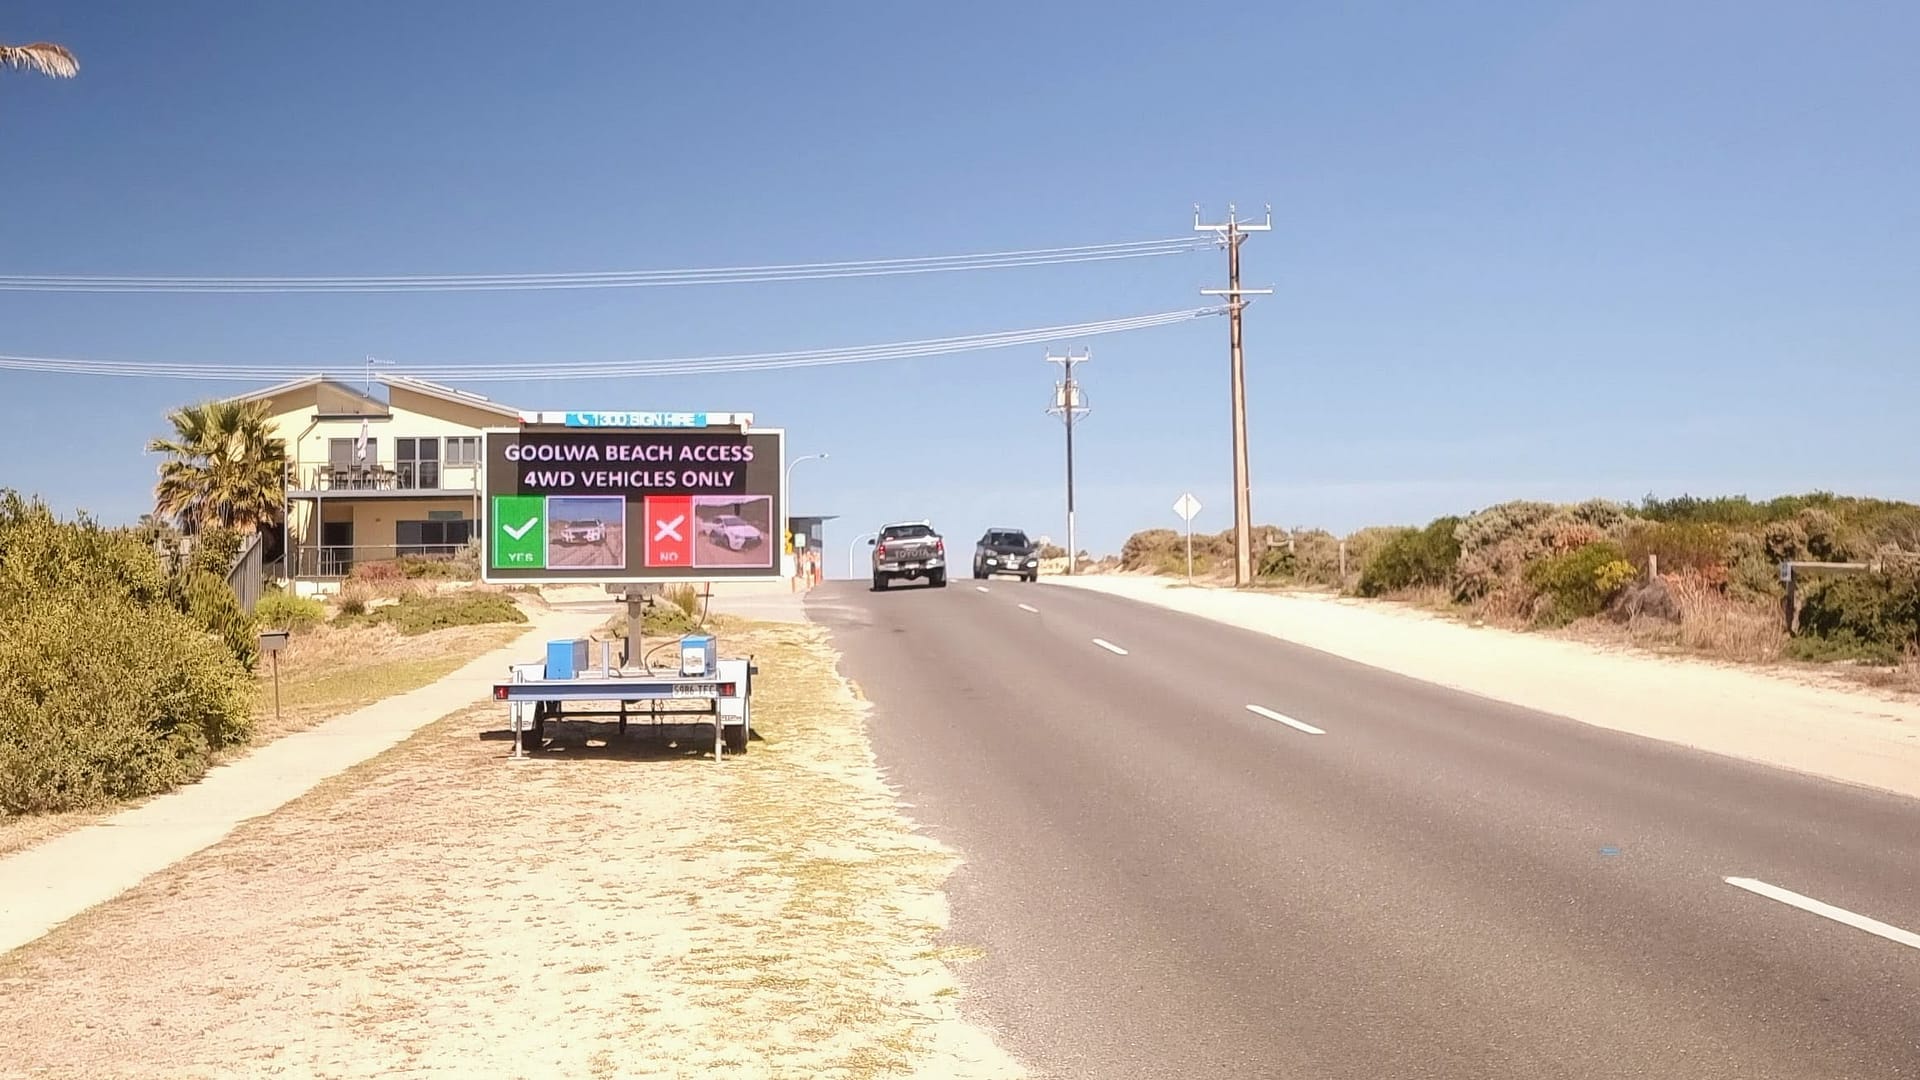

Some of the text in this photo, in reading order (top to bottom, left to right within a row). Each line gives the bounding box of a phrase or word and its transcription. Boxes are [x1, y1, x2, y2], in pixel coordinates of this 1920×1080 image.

[504, 443, 754, 462] GOOLWA BEACH ACCESS
[524, 470, 735, 488] 4WD VEHICLES ONLY
[508, 552, 534, 562] YES
[659, 552, 679, 562] NO
[895, 548, 930, 558] TOYOTA
